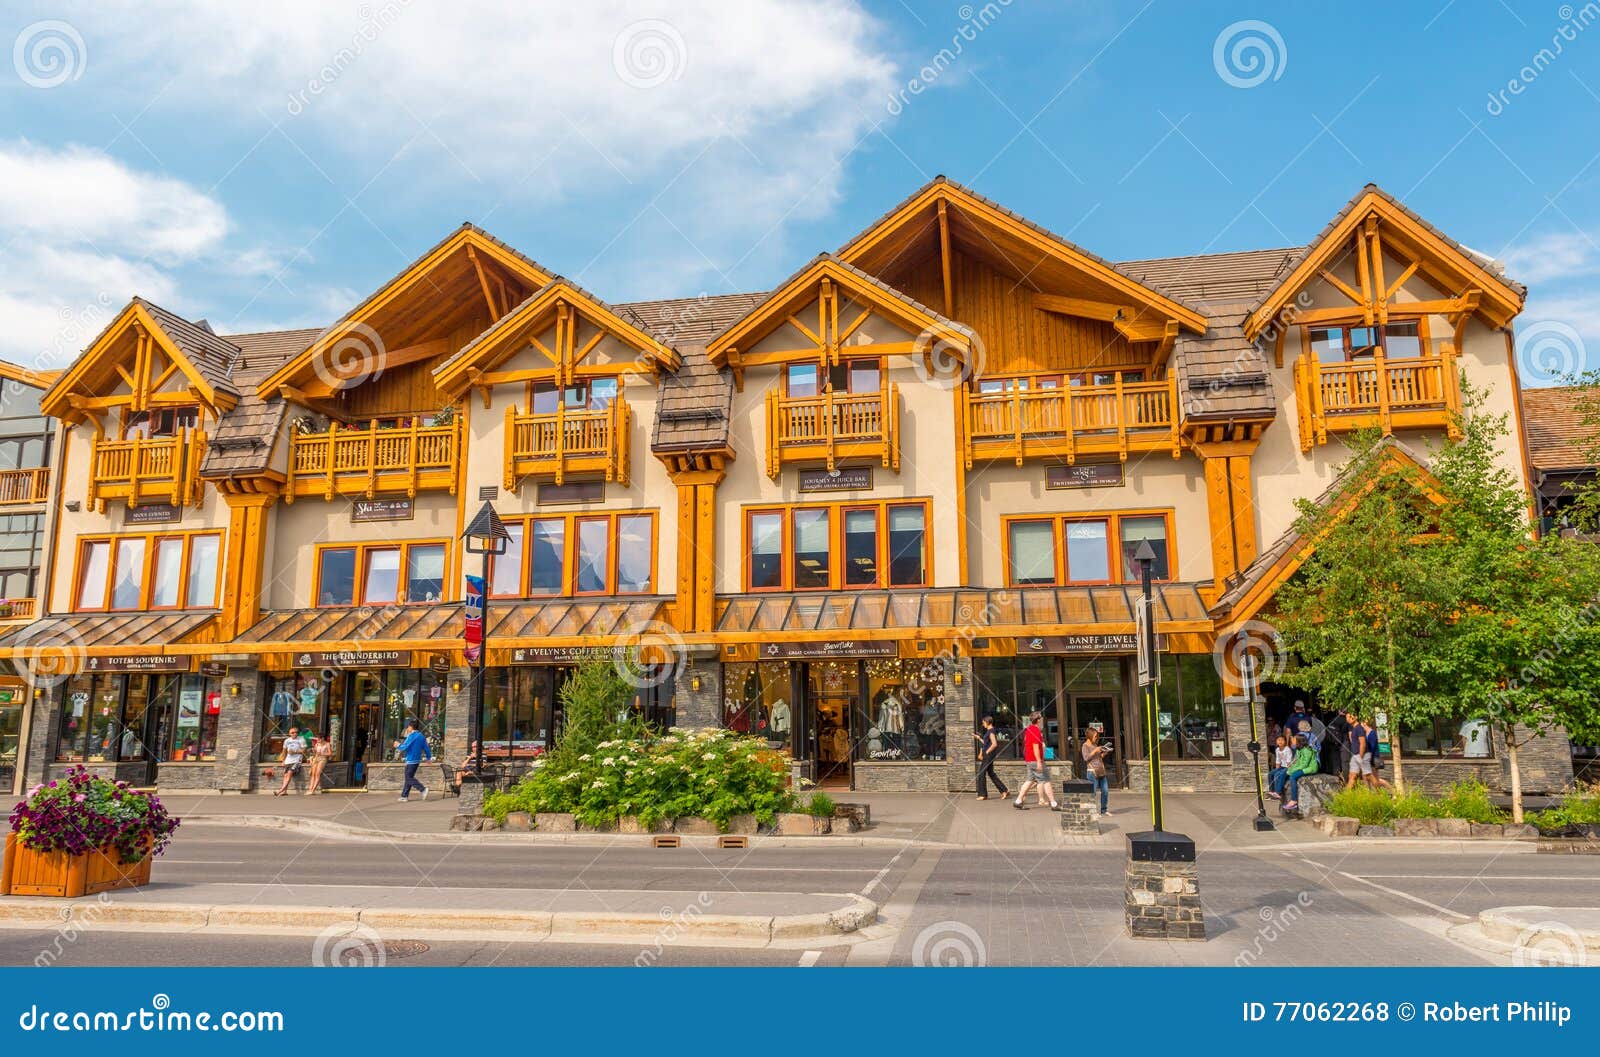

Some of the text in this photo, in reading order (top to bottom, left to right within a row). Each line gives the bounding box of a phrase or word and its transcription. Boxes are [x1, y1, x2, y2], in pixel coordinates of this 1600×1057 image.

[340, 651, 399, 660] THUNDERBIRD
[529, 646, 628, 656] EVELYN'S COFFEE WORL
[135, 656, 177, 664] SOUVENIRS
